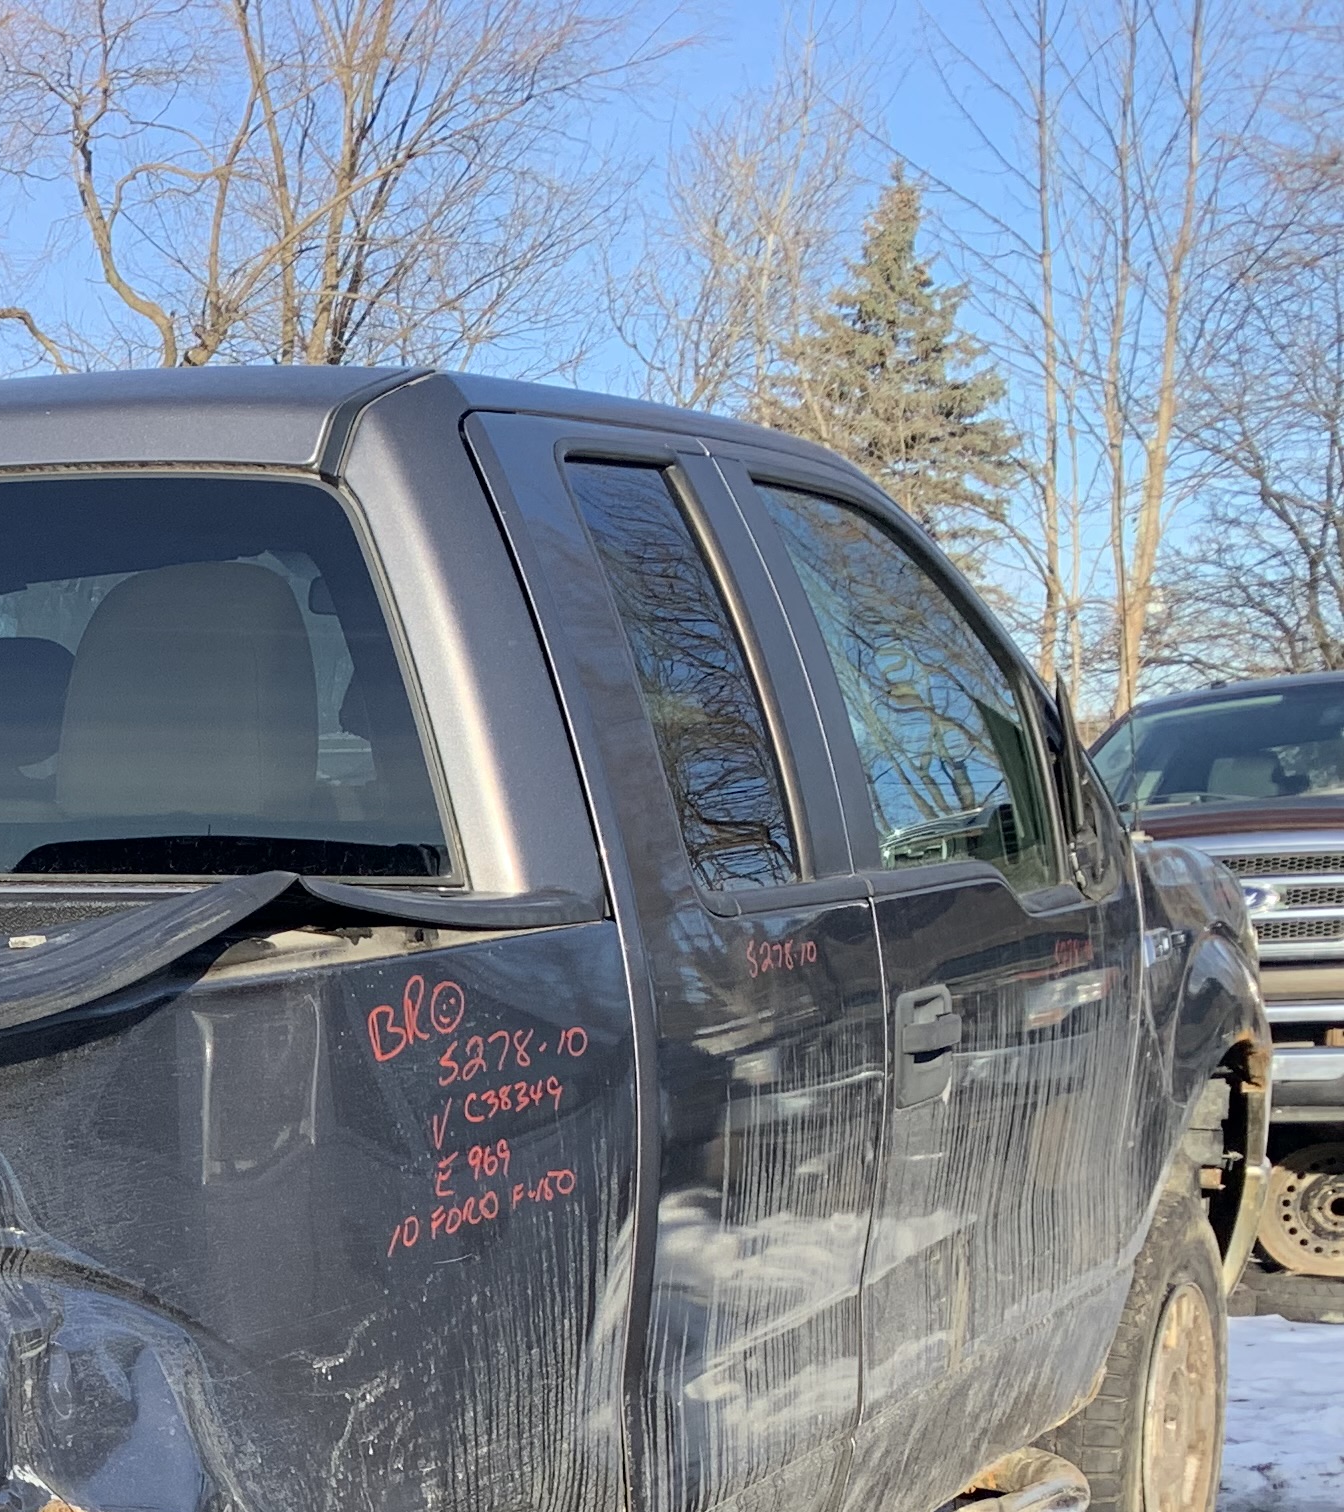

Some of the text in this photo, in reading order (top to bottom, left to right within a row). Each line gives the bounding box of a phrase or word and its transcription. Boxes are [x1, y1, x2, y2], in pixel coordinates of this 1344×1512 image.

[432, 1075, 563, 1150] V C38349
[435, 1138, 510, 1197] E 969
[387, 1215, 420, 1257] 10
